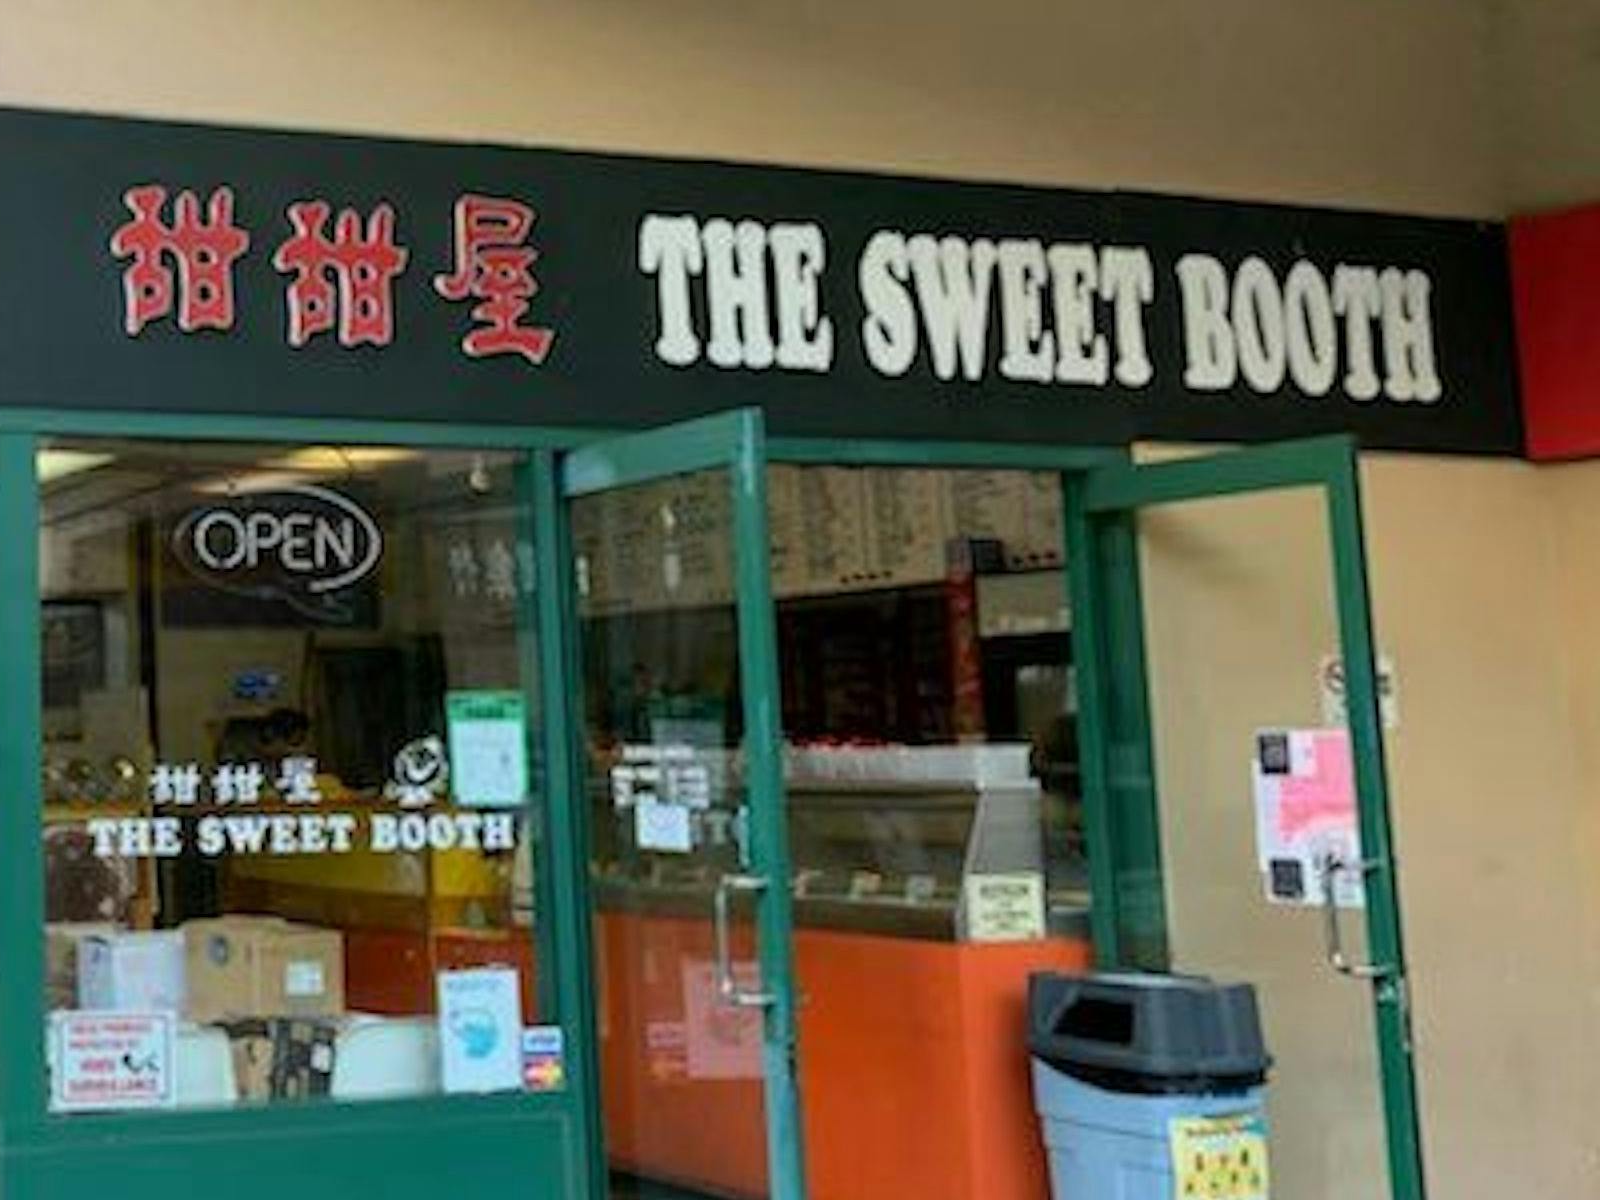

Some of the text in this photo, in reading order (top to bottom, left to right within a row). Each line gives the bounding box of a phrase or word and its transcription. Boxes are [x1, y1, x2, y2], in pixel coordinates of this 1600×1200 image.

[110, 184, 555, 363] 甜甜屋
[637, 214, 1443, 402] THE SWEET BOOTH
[195, 509, 355, 572] OPEN
[87, 813, 515, 857] THE SWEET BOOTH
